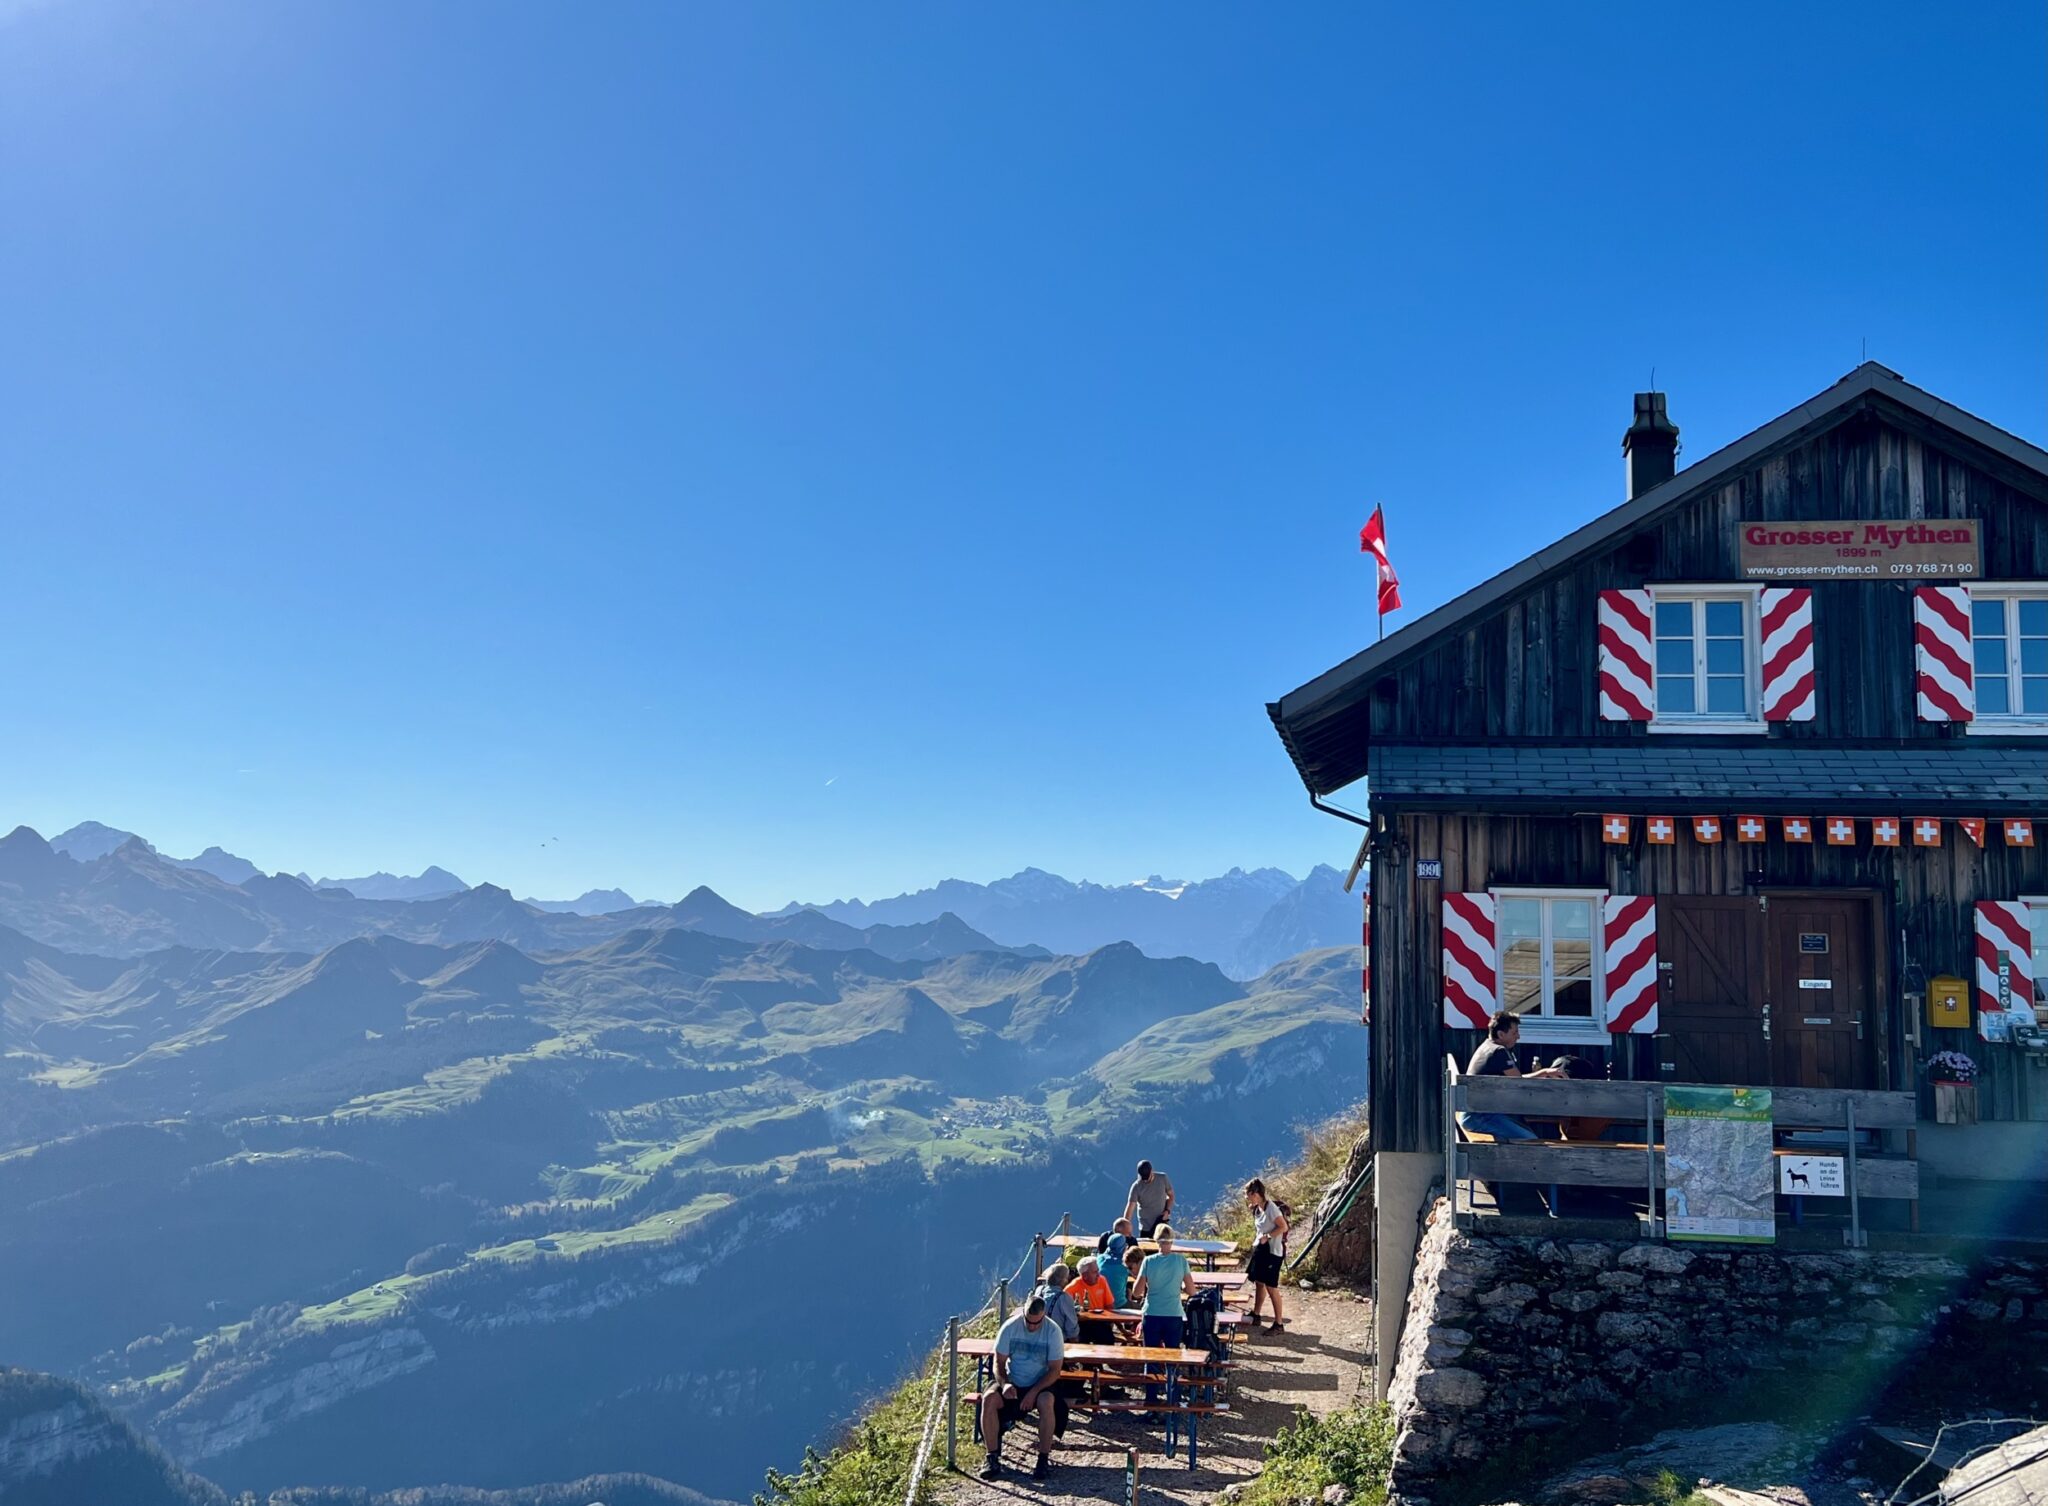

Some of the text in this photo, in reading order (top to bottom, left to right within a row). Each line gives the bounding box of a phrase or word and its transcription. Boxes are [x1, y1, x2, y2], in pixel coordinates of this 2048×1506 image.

[1746, 524, 1971, 548] Grosser Mythen
[1836, 548, 1866, 558] 1899
[1747, 564, 1972, 576] www.grosser-mythen.ch 079 768 71 90
[1418, 864, 1440, 876] 1991
